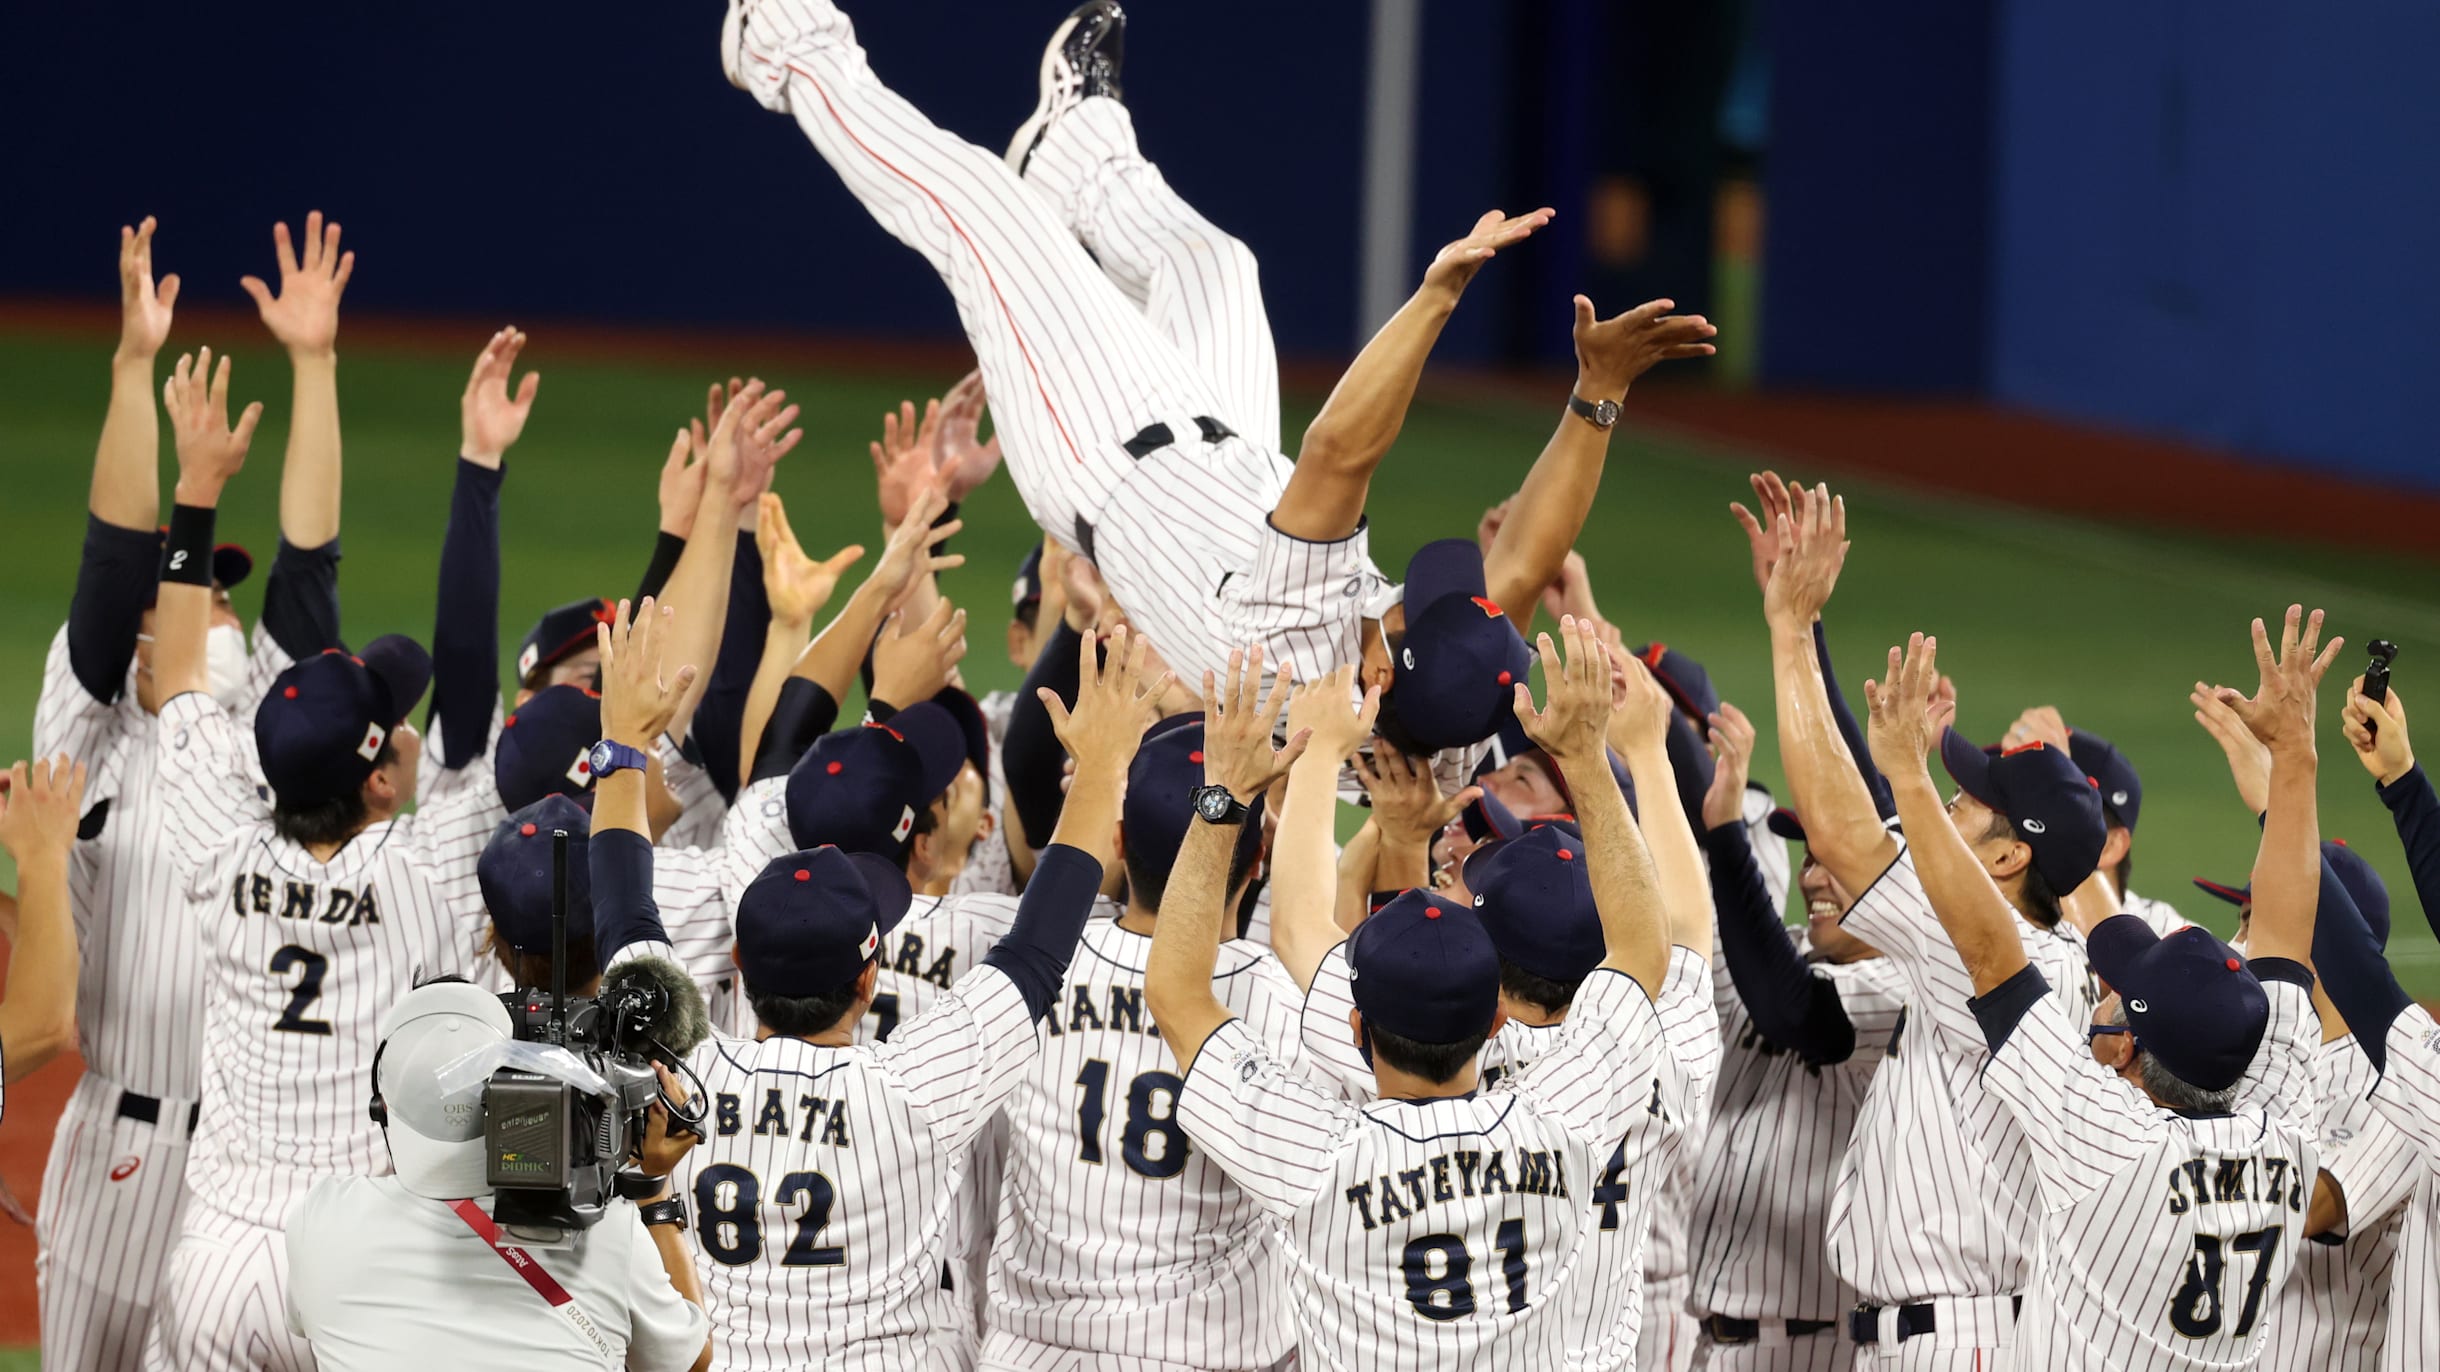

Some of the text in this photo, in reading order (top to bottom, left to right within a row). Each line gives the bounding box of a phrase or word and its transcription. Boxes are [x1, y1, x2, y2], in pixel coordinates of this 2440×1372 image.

[169, 549, 188, 570] 2
[269, 944, 333, 1036] 2
[444, 1103, 473, 1114] OBS
[1074, 1057, 1193, 1180] 18
[692, 1163, 847, 1268] 82
[1398, 1216, 1530, 1323] 81
[566, 1305, 611, 1359] TOKYO 2020
